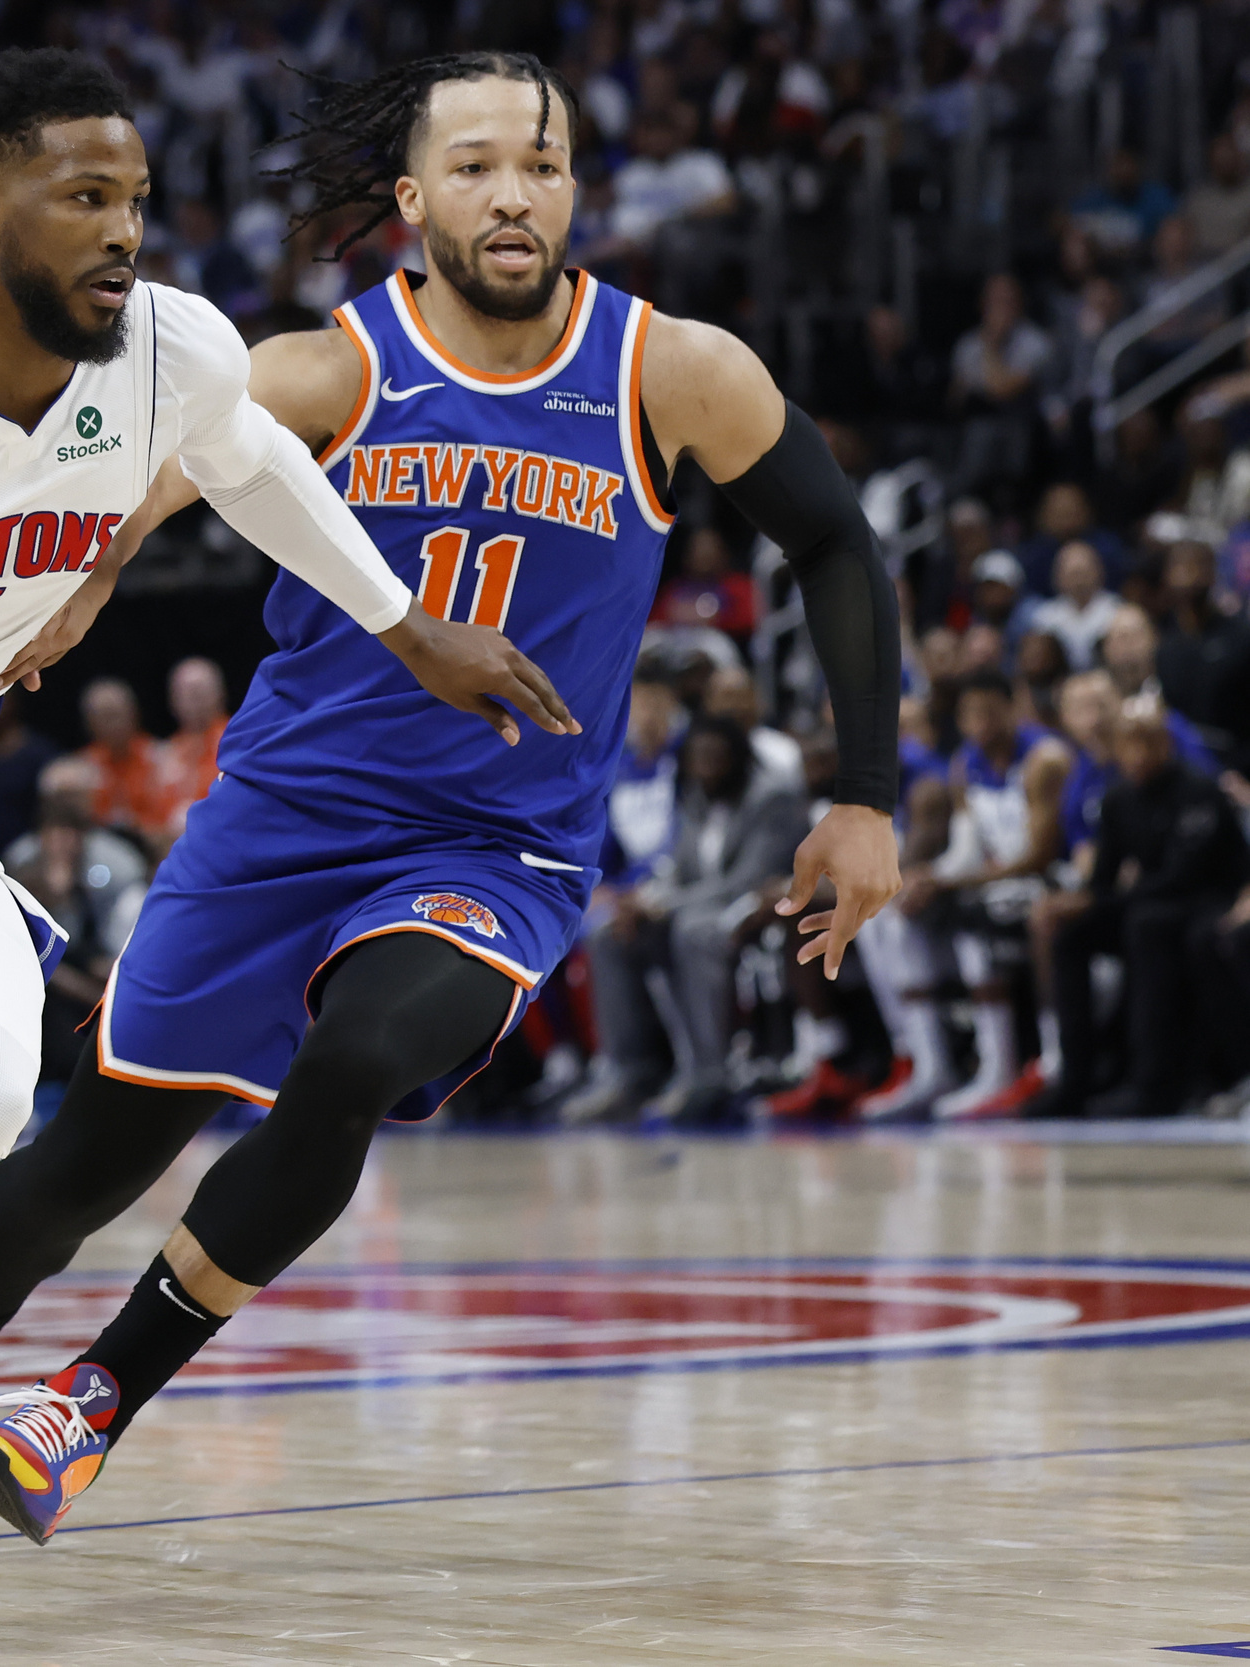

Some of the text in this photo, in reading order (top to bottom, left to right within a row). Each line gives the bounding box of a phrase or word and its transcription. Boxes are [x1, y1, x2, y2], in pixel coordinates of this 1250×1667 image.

[543, 398, 616, 417] abu dhabi
[57, 433, 122, 462] StockX
[344, 442, 625, 541] NEW YORK
[416, 526, 526, 634] 11
[416, 893, 495, 935] KNICKS
